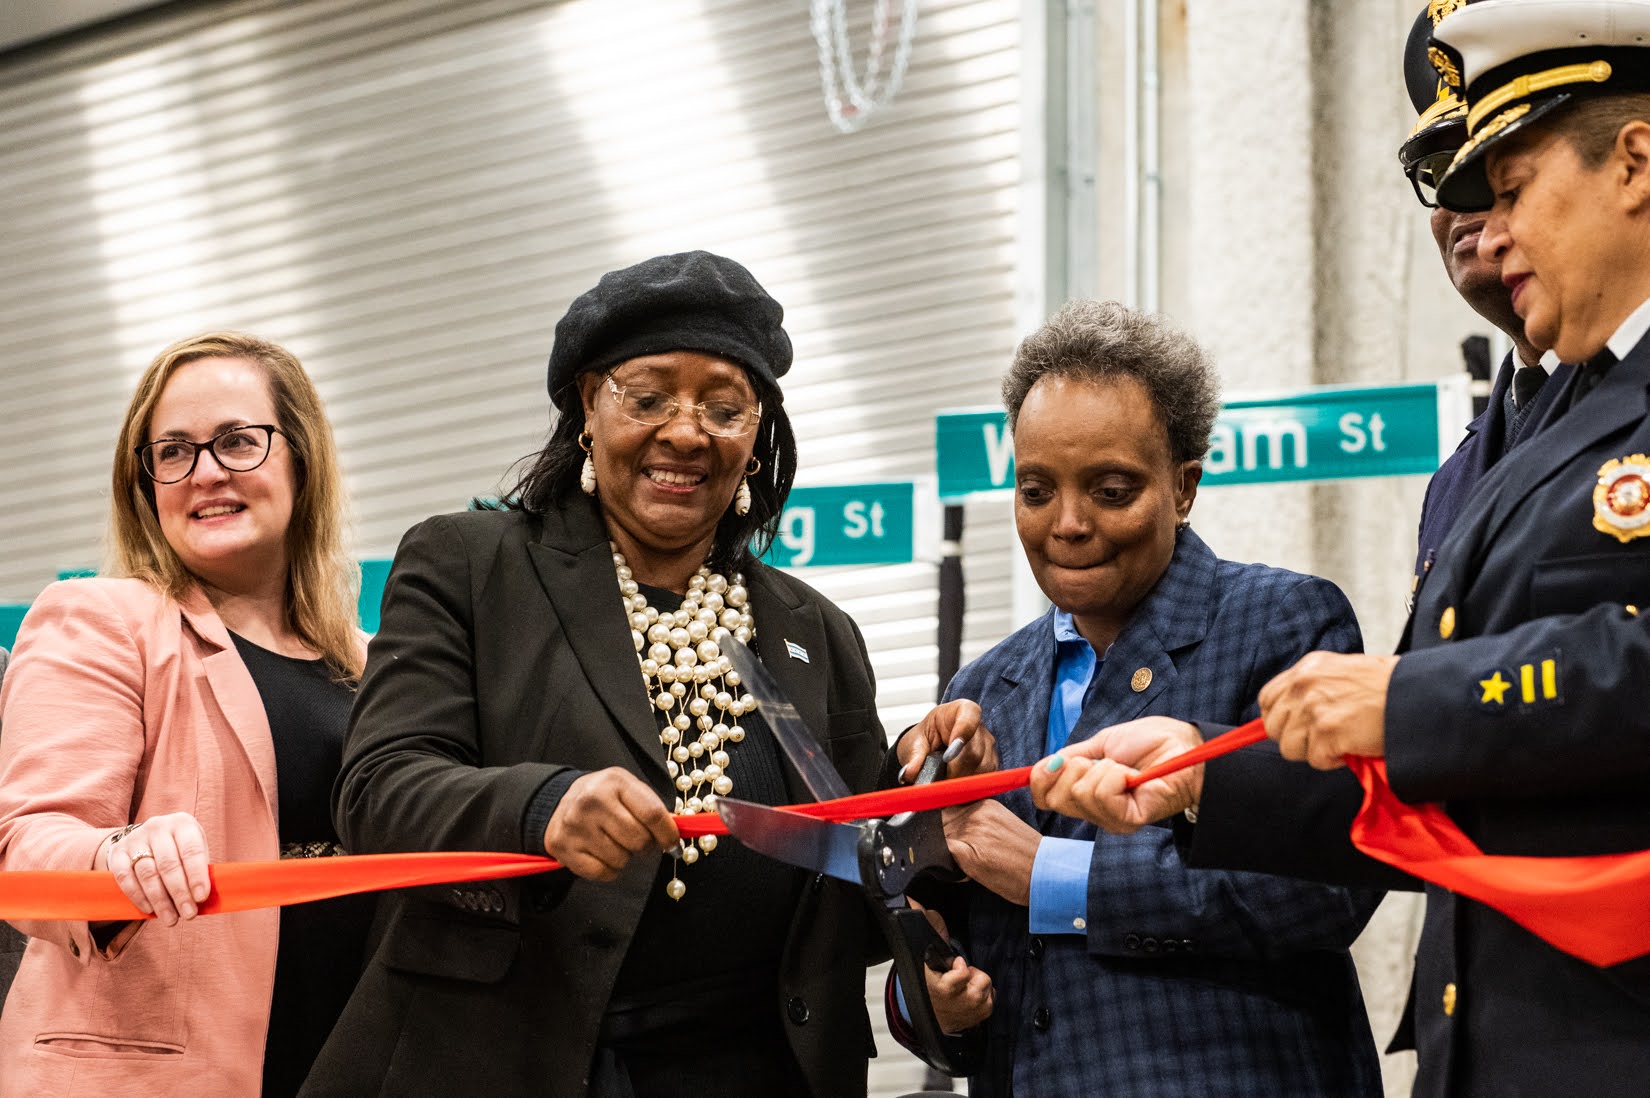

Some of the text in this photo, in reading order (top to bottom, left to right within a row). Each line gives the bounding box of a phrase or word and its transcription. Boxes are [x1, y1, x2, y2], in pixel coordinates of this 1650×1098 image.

[1202, 420, 1308, 474] am
[1339, 412, 1386, 453] St
[843, 501, 884, 538] St
